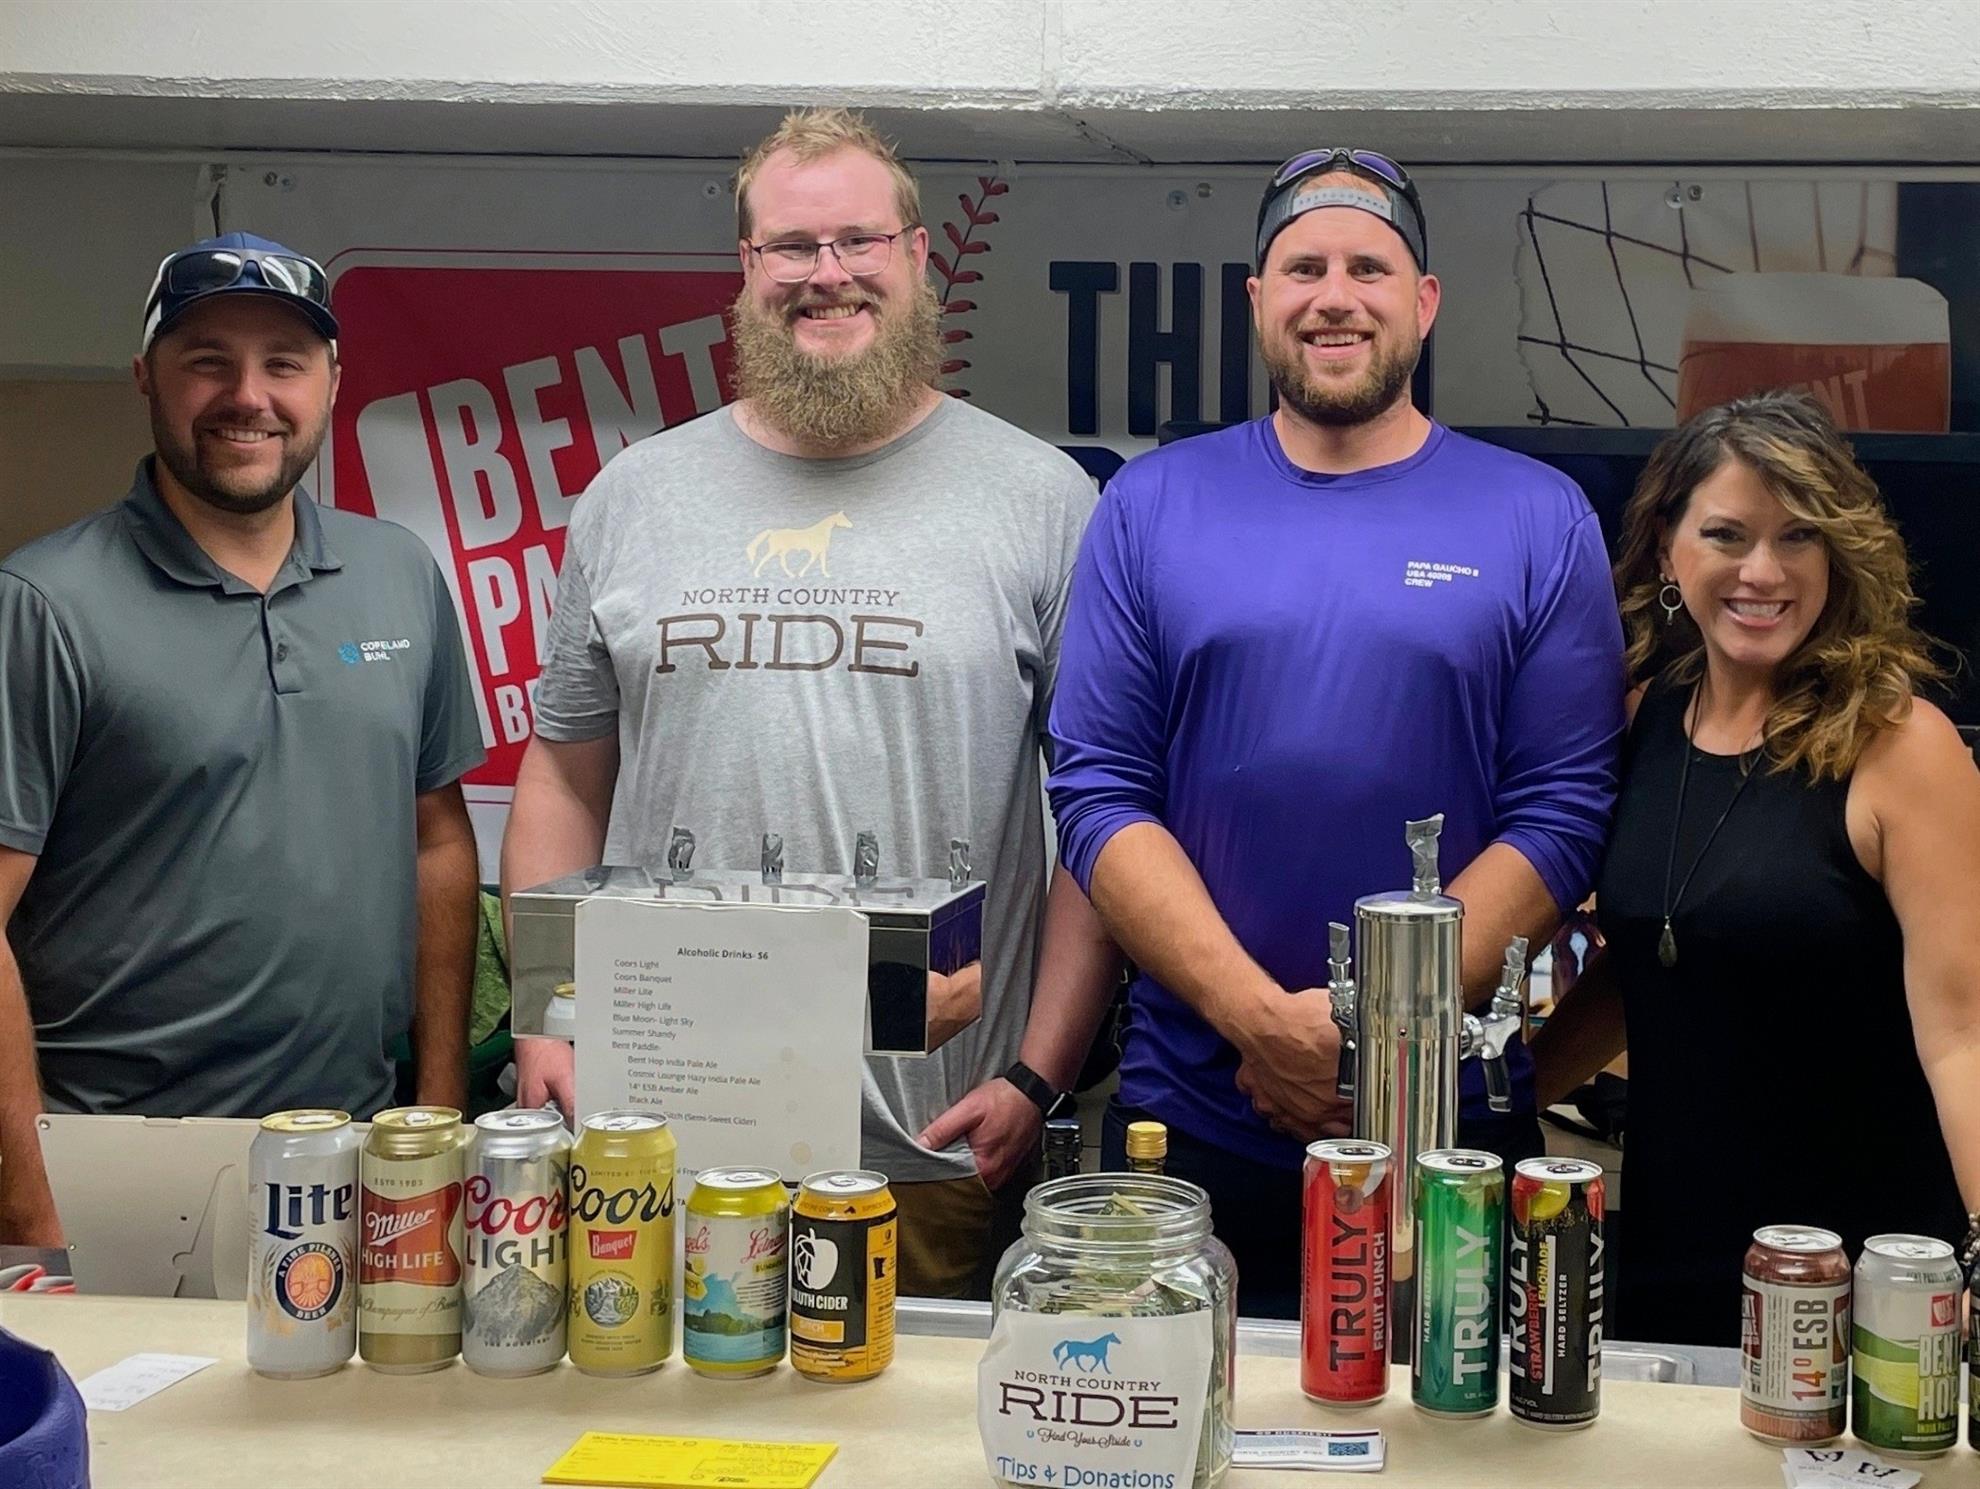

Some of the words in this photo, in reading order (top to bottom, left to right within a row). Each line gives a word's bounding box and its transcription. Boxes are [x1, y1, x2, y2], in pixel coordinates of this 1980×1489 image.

[427, 315, 728, 551] BENT
[1406, 569, 1425, 578] USA
[1407, 561, 1431, 570] PAPA
[1432, 563, 1472, 576] GAUCHO
[1404, 578, 1434, 587] CREW
[681, 588, 770, 606] NORTH
[777, 588, 900, 607] COUNTRY
[360, 639, 410, 651] COPELAND
[363, 651, 391, 661] BUHL
[656, 613, 924, 677] RIDE
[677, 947, 719, 959] Alcoholic
[614, 959, 637, 969] Coors
[639, 960, 660, 970] Light
[614, 972, 637, 982] Coors
[639, 974, 672, 984] Banquet
[613, 986, 636, 995] Miller
[638, 988, 653, 997] Lite
[613, 999, 635, 1008] Miller
[638, 1000, 656, 1011] High
[657, 1002, 672, 1011] Life
[612, 1013, 631, 1023] Blue
[659, 1016, 678, 1026] Light
[680, 1017, 694, 1028] Sky
[612, 1027, 645, 1037] Summer
[647, 1029, 677, 1040] Shandy
[612, 1041, 631, 1050] Bent
[627, 1056, 647, 1065] Bent
[648, 1057, 665, 1067] Hop
[666, 1057, 686, 1067] India
[687, 1058, 704, 1068] Pale
[705, 1060, 718, 1069] Ale
[627, 1069, 655, 1078] Cosmic
[657, 1070, 686, 1081] Lounge
[687, 1072, 707, 1084] Hazy
[708, 1073, 728, 1083] India
[729, 1075, 747, 1085] Pale
[748, 1076, 761, 1086] Ale
[629, 1095, 649, 1104] Black
[650, 1096, 663, 1105] Ale
[659, 1084, 685, 1094] Amber
[686, 1086, 699, 1095] Ale
[733, 1116, 757, 1127] Cider)
[399, 1178, 423, 1187] 1903
[464, 1175, 567, 1235] Coor
[570, 1164, 674, 1224] Coors
[264, 1182, 352, 1240] Lite
[366, 1209, 437, 1242] Miller
[466, 1230, 568, 1268] LIGHT
[592, 1234, 633, 1257] Banquet
[362, 1247, 397, 1268] HIGH
[402, 1251, 444, 1269] LIFE
[1373, 1232, 1385, 1299] PUNCH
[1538, 1241, 1549, 1307] LEMONADE
[816, 1295, 848, 1311] CIDER
[1330, 1215, 1367, 1372] TRULY
[1558, 1274, 1567, 1321] SELTZER
[1453, 1225, 1490, 1385] TRULY
[1373, 1302, 1385, 1350] FRUIT
[1423, 1311, 1431, 1343] HARD
[1526, 1280, 1543, 1384] STRAWBERRY
[1793, 1300, 1828, 1349] ESB
[1558, 1326, 1567, 1357] HARD
[1919, 1331, 1960, 1377] BENT
[1014, 1370, 1071, 1387] NORTH
[1076, 1378, 1161, 1391] COUNTRY
[999, 1381, 1179, 1429] RIDE
[1037, 1427, 1067, 1443] Find
[1067, 1430, 1096, 1447] Your
[1097, 1434, 1131, 1449] Stride
[997, 1456, 1038, 1480] Tips
[1044, 1465, 1057, 1482] &
[1064, 1465, 1175, 1489] Donations
